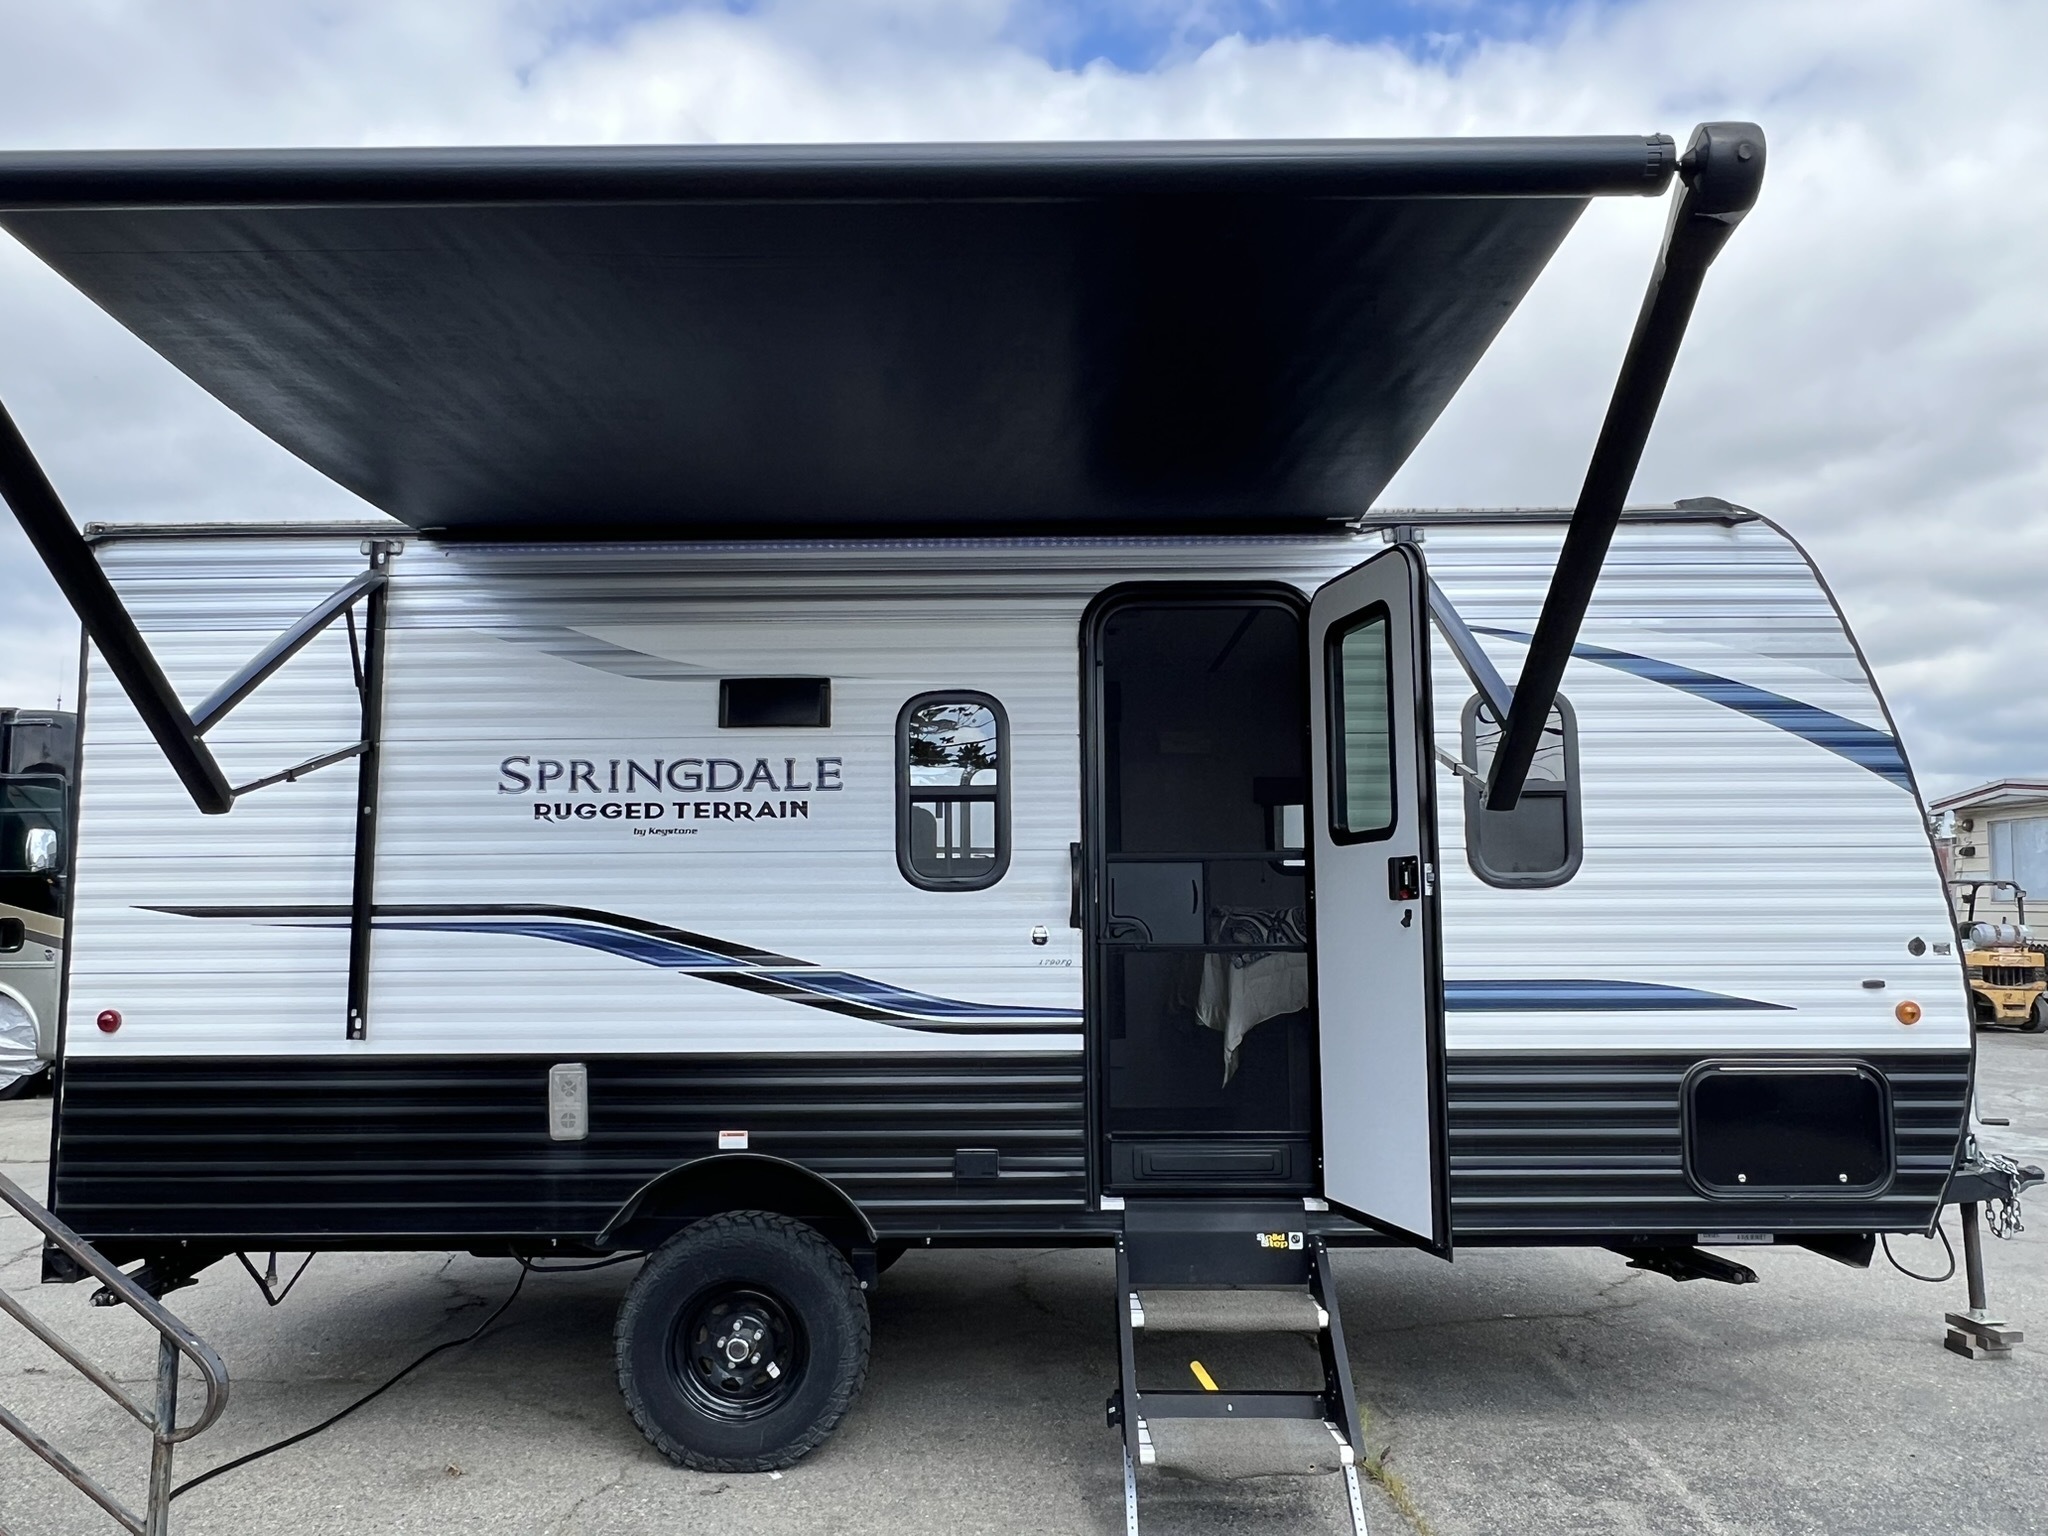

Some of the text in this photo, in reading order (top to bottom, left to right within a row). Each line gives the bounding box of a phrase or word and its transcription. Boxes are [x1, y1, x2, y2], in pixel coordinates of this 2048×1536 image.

[498, 756, 843, 794] SPRINGDALE
[534, 800, 808, 823] RUGGED TERRAIN
[633, 826, 698, 836] by Keystone
